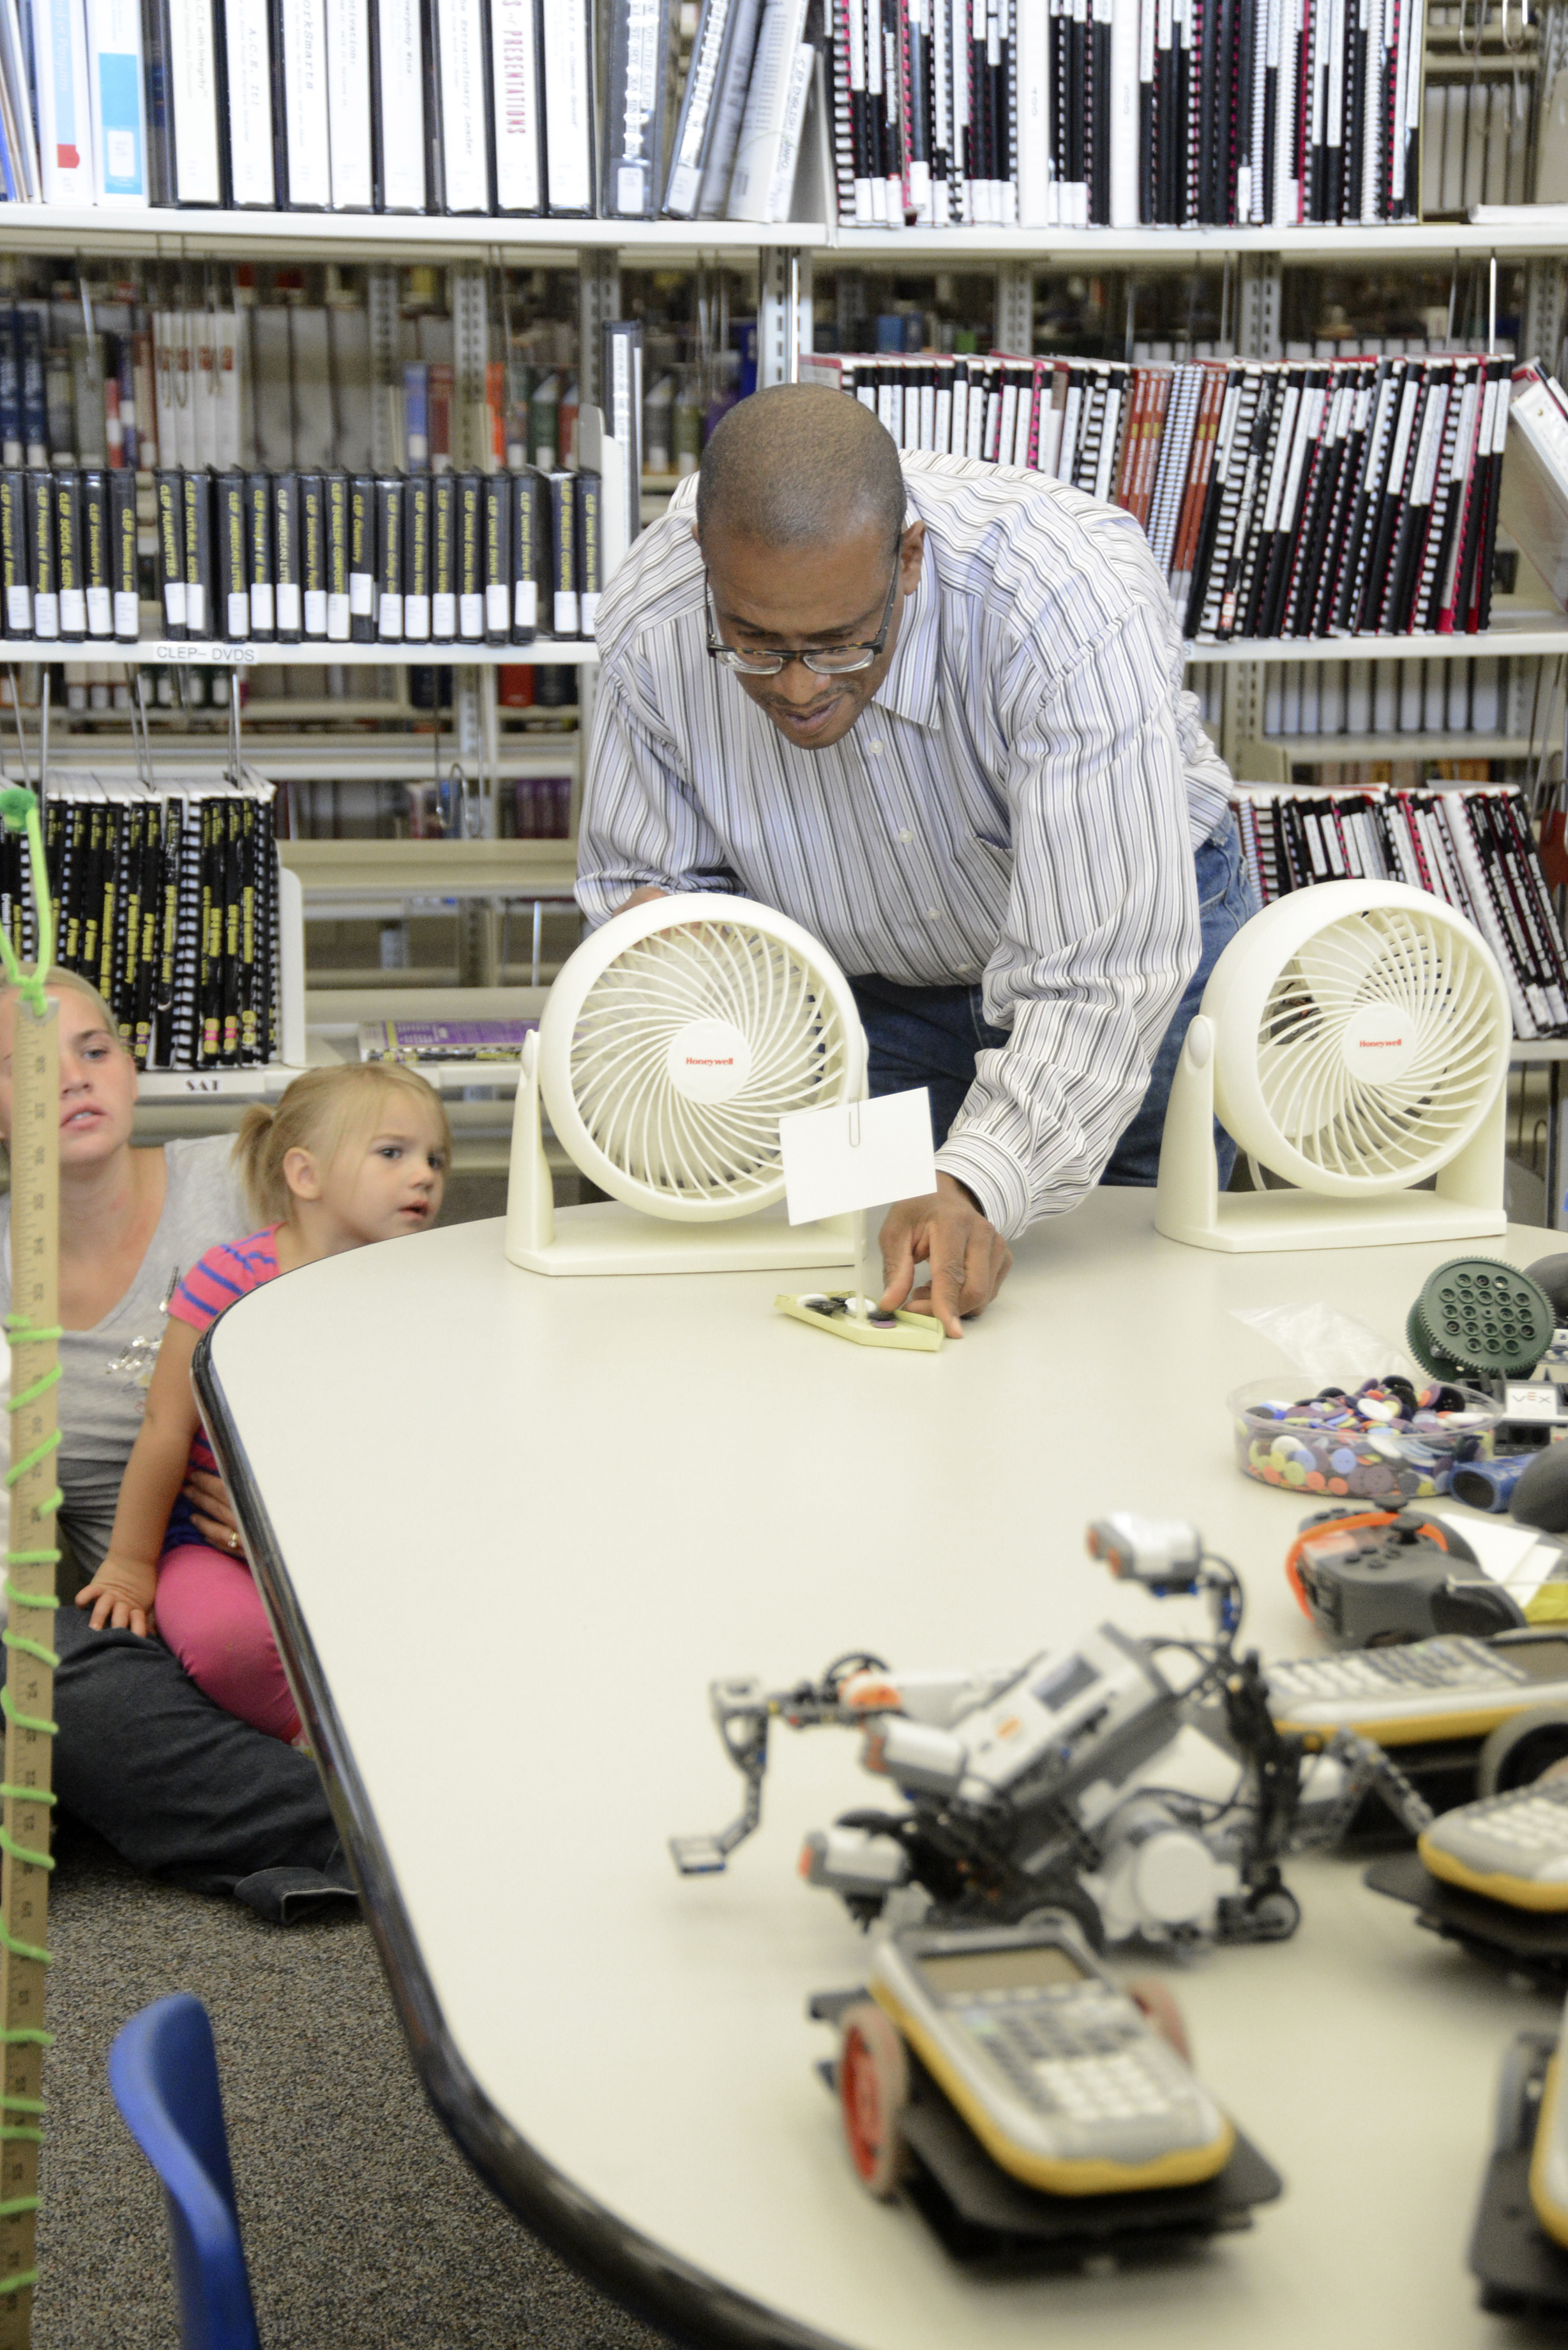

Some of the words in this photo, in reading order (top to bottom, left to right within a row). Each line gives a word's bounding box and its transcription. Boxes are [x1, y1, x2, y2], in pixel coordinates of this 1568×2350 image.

[195, 0, 205, 24] .C.T.
[197, 26, 207, 46] with
[502, 30, 527, 134] PRESENTATIONS
[787, 86, 803, 130] ENGLISH
[886, 70, 896, 123] Mathematics
[617, 337, 626, 371] REVIEW
[1, 484, 11, 505] CLEP
[37, 487, 49, 508] CLEP
[59, 492, 72, 516] CLEP
[160, 485, 174, 508] CLEP
[185, 481, 197, 504] CLEP
[229, 491, 241, 513] CLEP
[254, 490, 266, 511] CLEP
[278, 489, 290, 510] CLEP
[306, 494, 318, 515] CLEP
[331, 482, 343, 503] CLEP
[388, 494, 398, 514] CLEP
[415, 491, 427, 514] CLEP
[438, 489, 450, 510] CLEP
[464, 490, 476, 512] CLEP
[520, 491, 532, 513] CLEP
[561, 480, 573, 503] CLEP
[585, 494, 597, 515] CLEP
[89, 503, 100, 523] CLEP
[353, 494, 365, 518] CLEP
[488, 496, 500, 518] CLEP
[2, 506, 13, 547] Principles
[36, 509, 49, 549] Principles
[122, 508, 133, 532] CLEP
[186, 506, 198, 553] NATURAL
[332, 505, 345, 545] ENGLISH
[414, 513, 426, 543] United
[438, 512, 449, 541] United
[464, 513, 476, 543] United
[488, 518, 500, 548] United
[521, 514, 532, 543] United
[561, 505, 573, 550] ENGLISH
[587, 516, 597, 545] United
[60, 518, 73, 556] SOCIAL
[162, 510, 179, 577] HUMANITIES
[230, 515, 243, 563] AMERICAN
[278, 512, 291, 561] AMERICAN
[306, 517, 319, 569] Introductory
[352, 519, 365, 563] Chemistry
[123, 534, 133, 573] Business
[414, 543, 426, 573] States
[438, 541, 449, 570] States
[464, 543, 476, 572] States
[489, 547, 500, 577] States
[521, 543, 532, 573] States
[586, 545, 597, 575] States
[212, 648, 255, 662] DVDS
[1359, 1038, 1402, 1049] Honeywell
[686, 1057, 734, 1067] Honeywell
[186, 1079, 221, 1092] SAT
[1511, 1391, 1552, 1404] VEX
